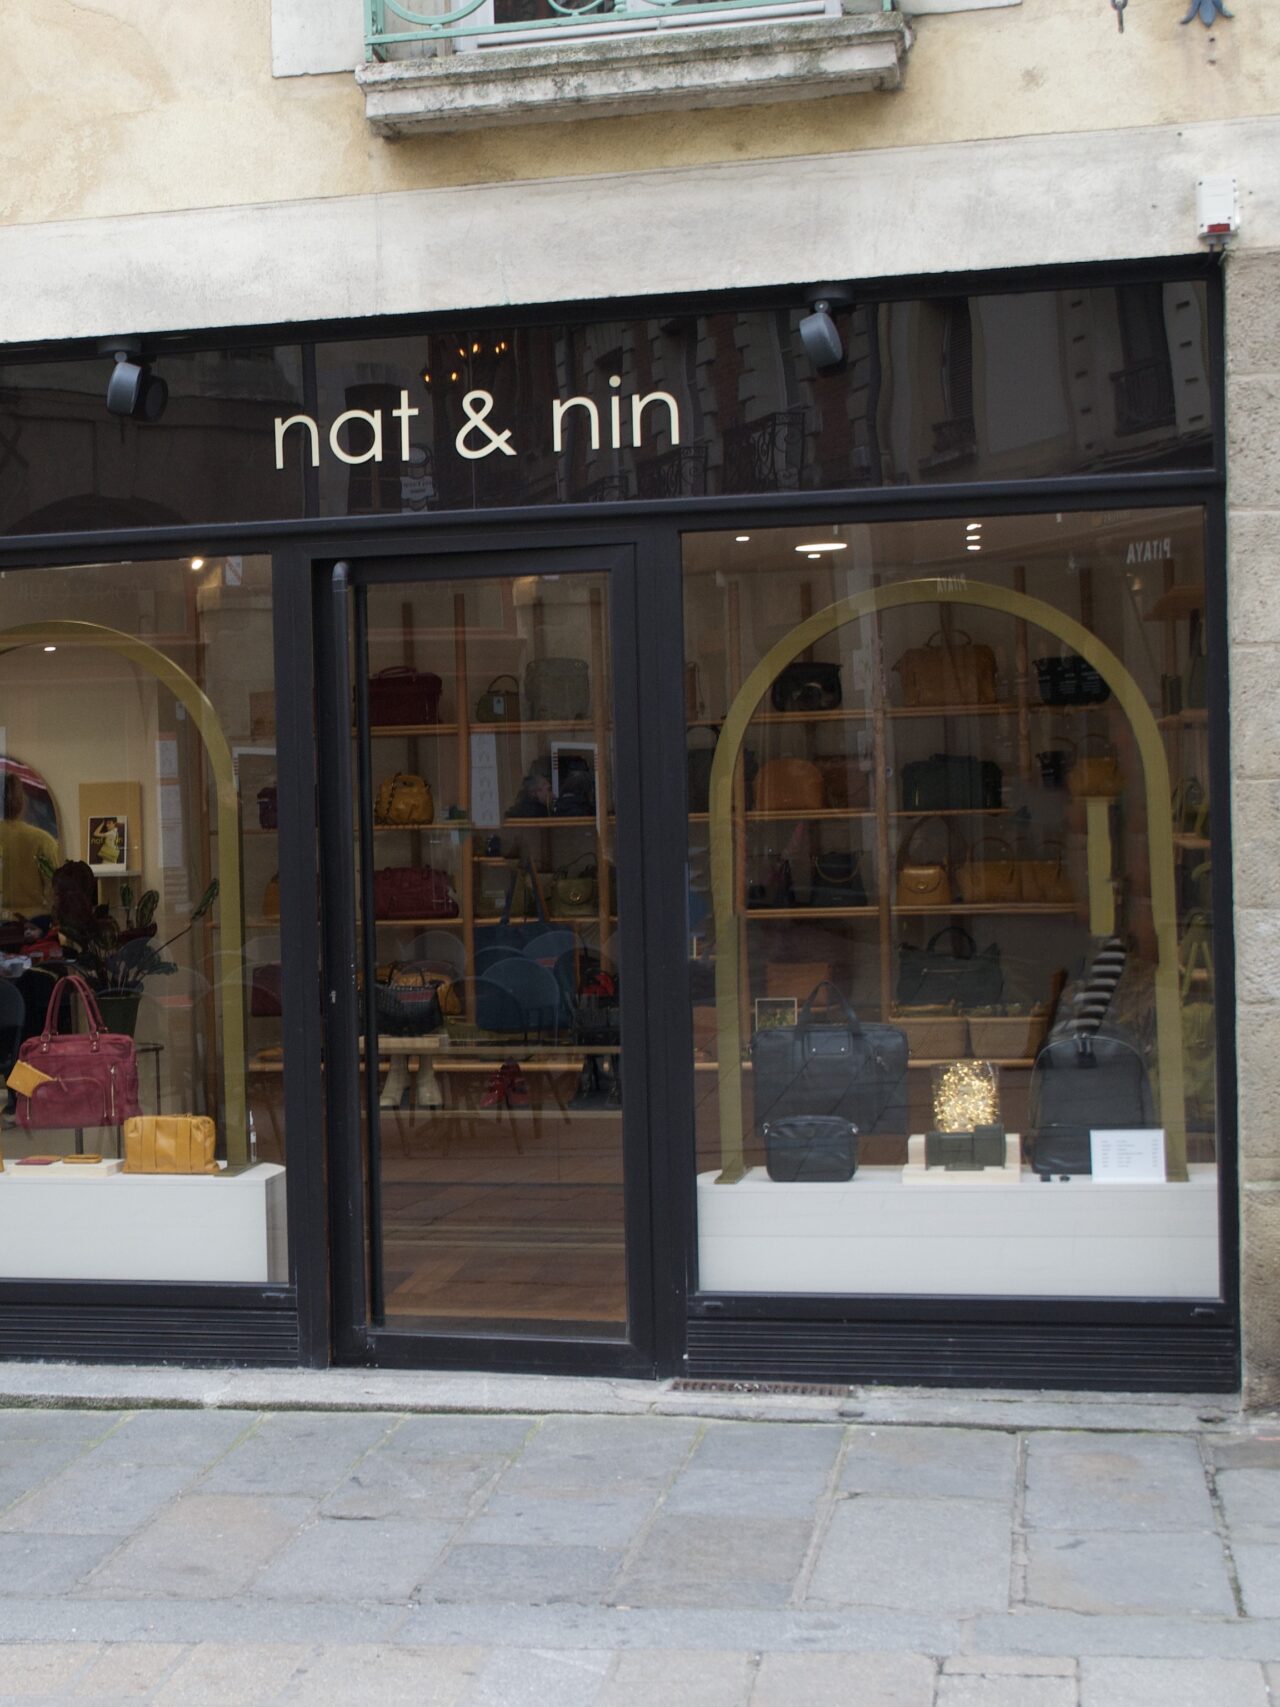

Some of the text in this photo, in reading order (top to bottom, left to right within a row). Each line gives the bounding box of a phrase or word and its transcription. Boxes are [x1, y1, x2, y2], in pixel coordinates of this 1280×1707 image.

[274, 375, 680, 470] nat & nin
